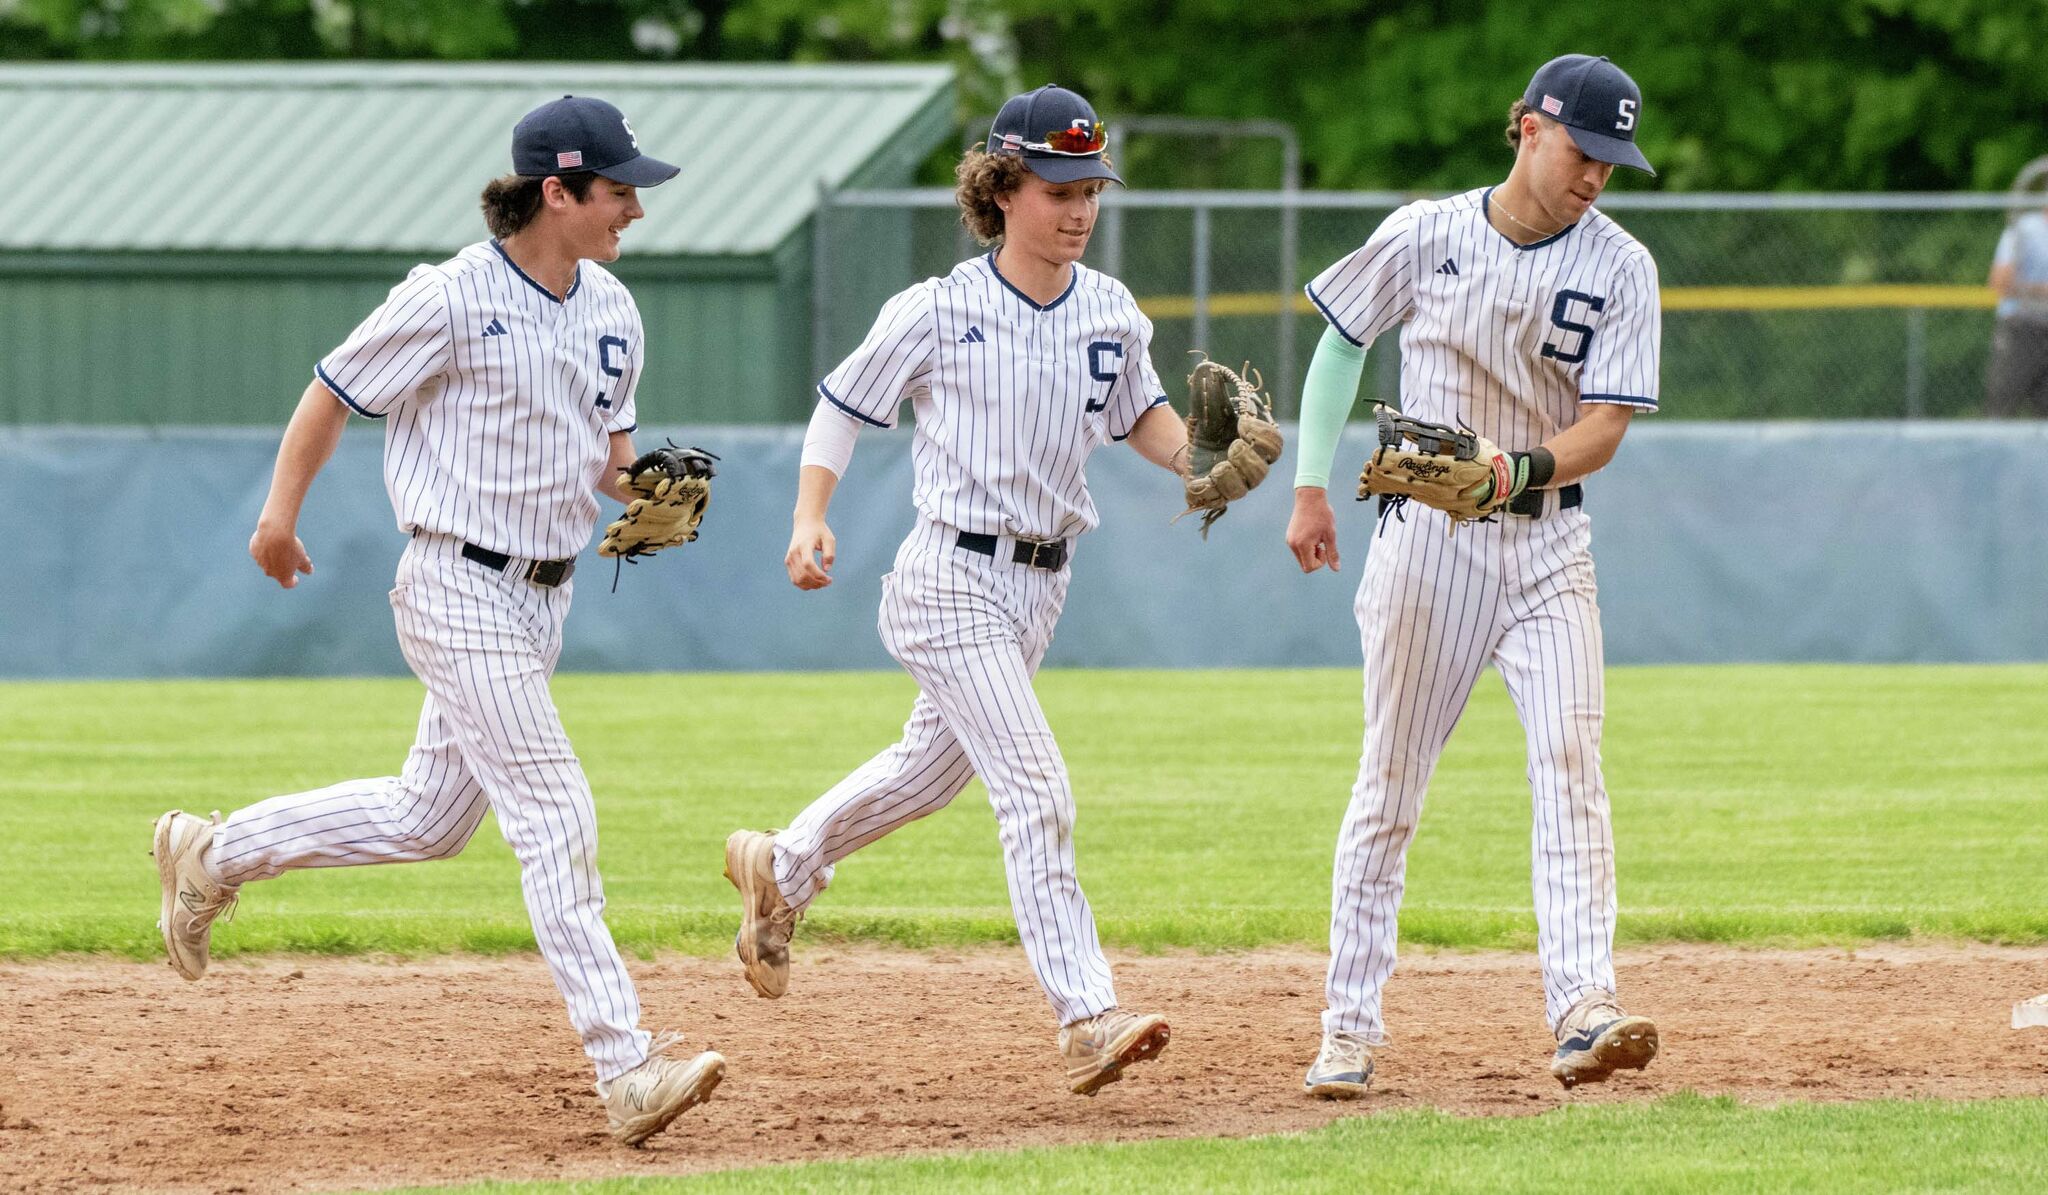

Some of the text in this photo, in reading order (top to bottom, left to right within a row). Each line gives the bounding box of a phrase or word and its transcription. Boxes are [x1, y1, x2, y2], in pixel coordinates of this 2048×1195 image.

[622, 117, 639, 149] S
[1615, 99, 1636, 132] S
[1540, 289, 1606, 363] S
[595, 334, 628, 409] S
[1085, 340, 1123, 413] S
[1398, 457, 1451, 477] Rawlings
